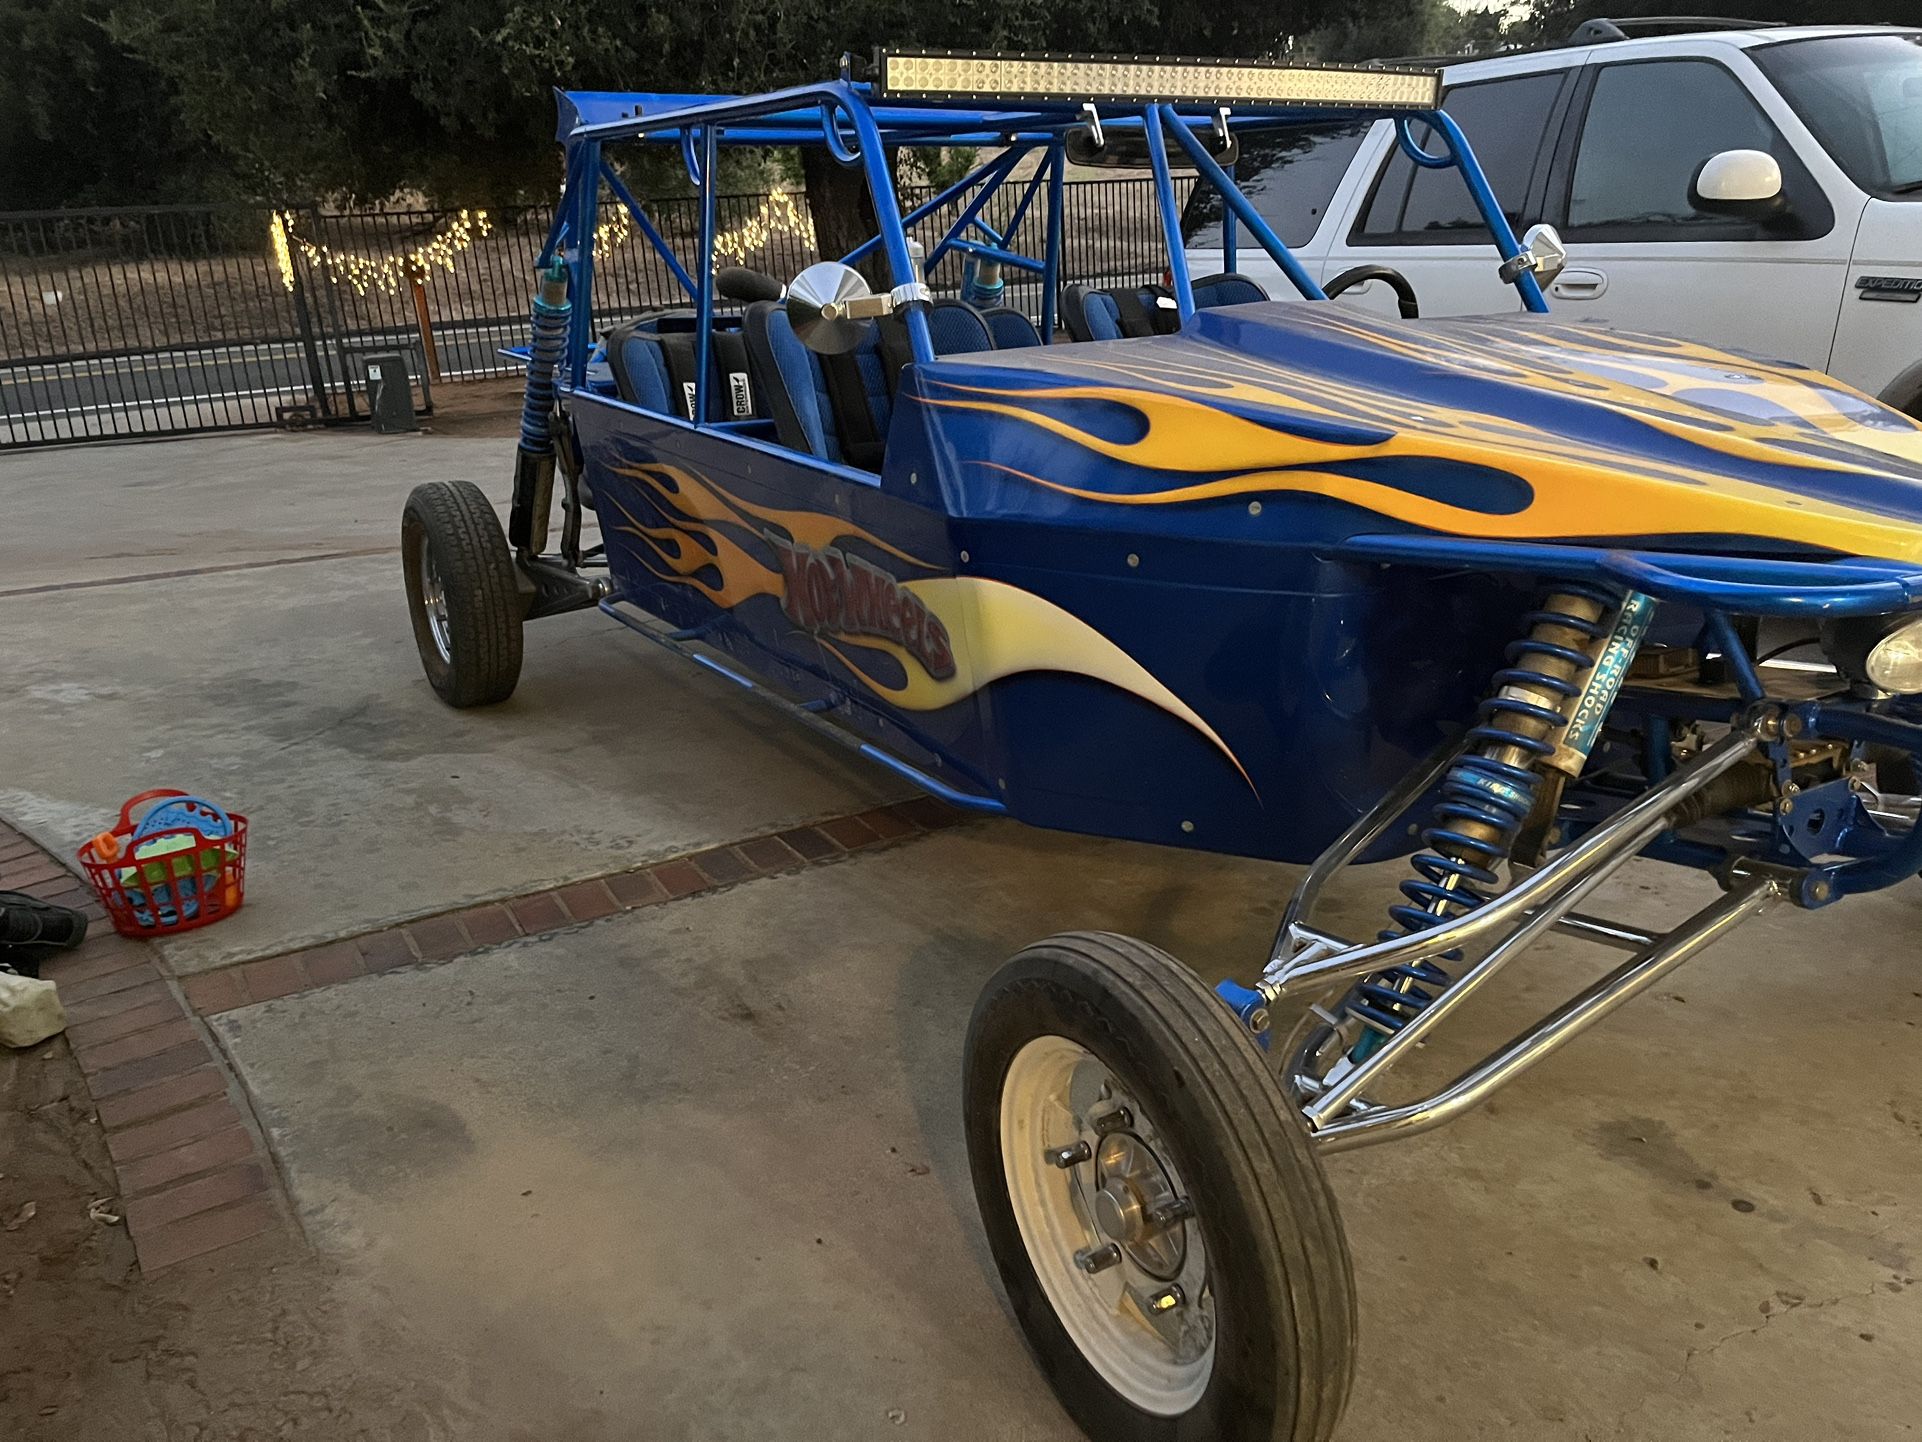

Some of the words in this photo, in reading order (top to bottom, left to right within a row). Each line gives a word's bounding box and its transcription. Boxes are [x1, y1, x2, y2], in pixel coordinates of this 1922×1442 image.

[733, 384, 746, 414] CROW
[1602, 599, 1641, 667] RACING
[1594, 625, 1640, 715] OFF-ROAD
[1568, 671, 1608, 740] SHOCKS
